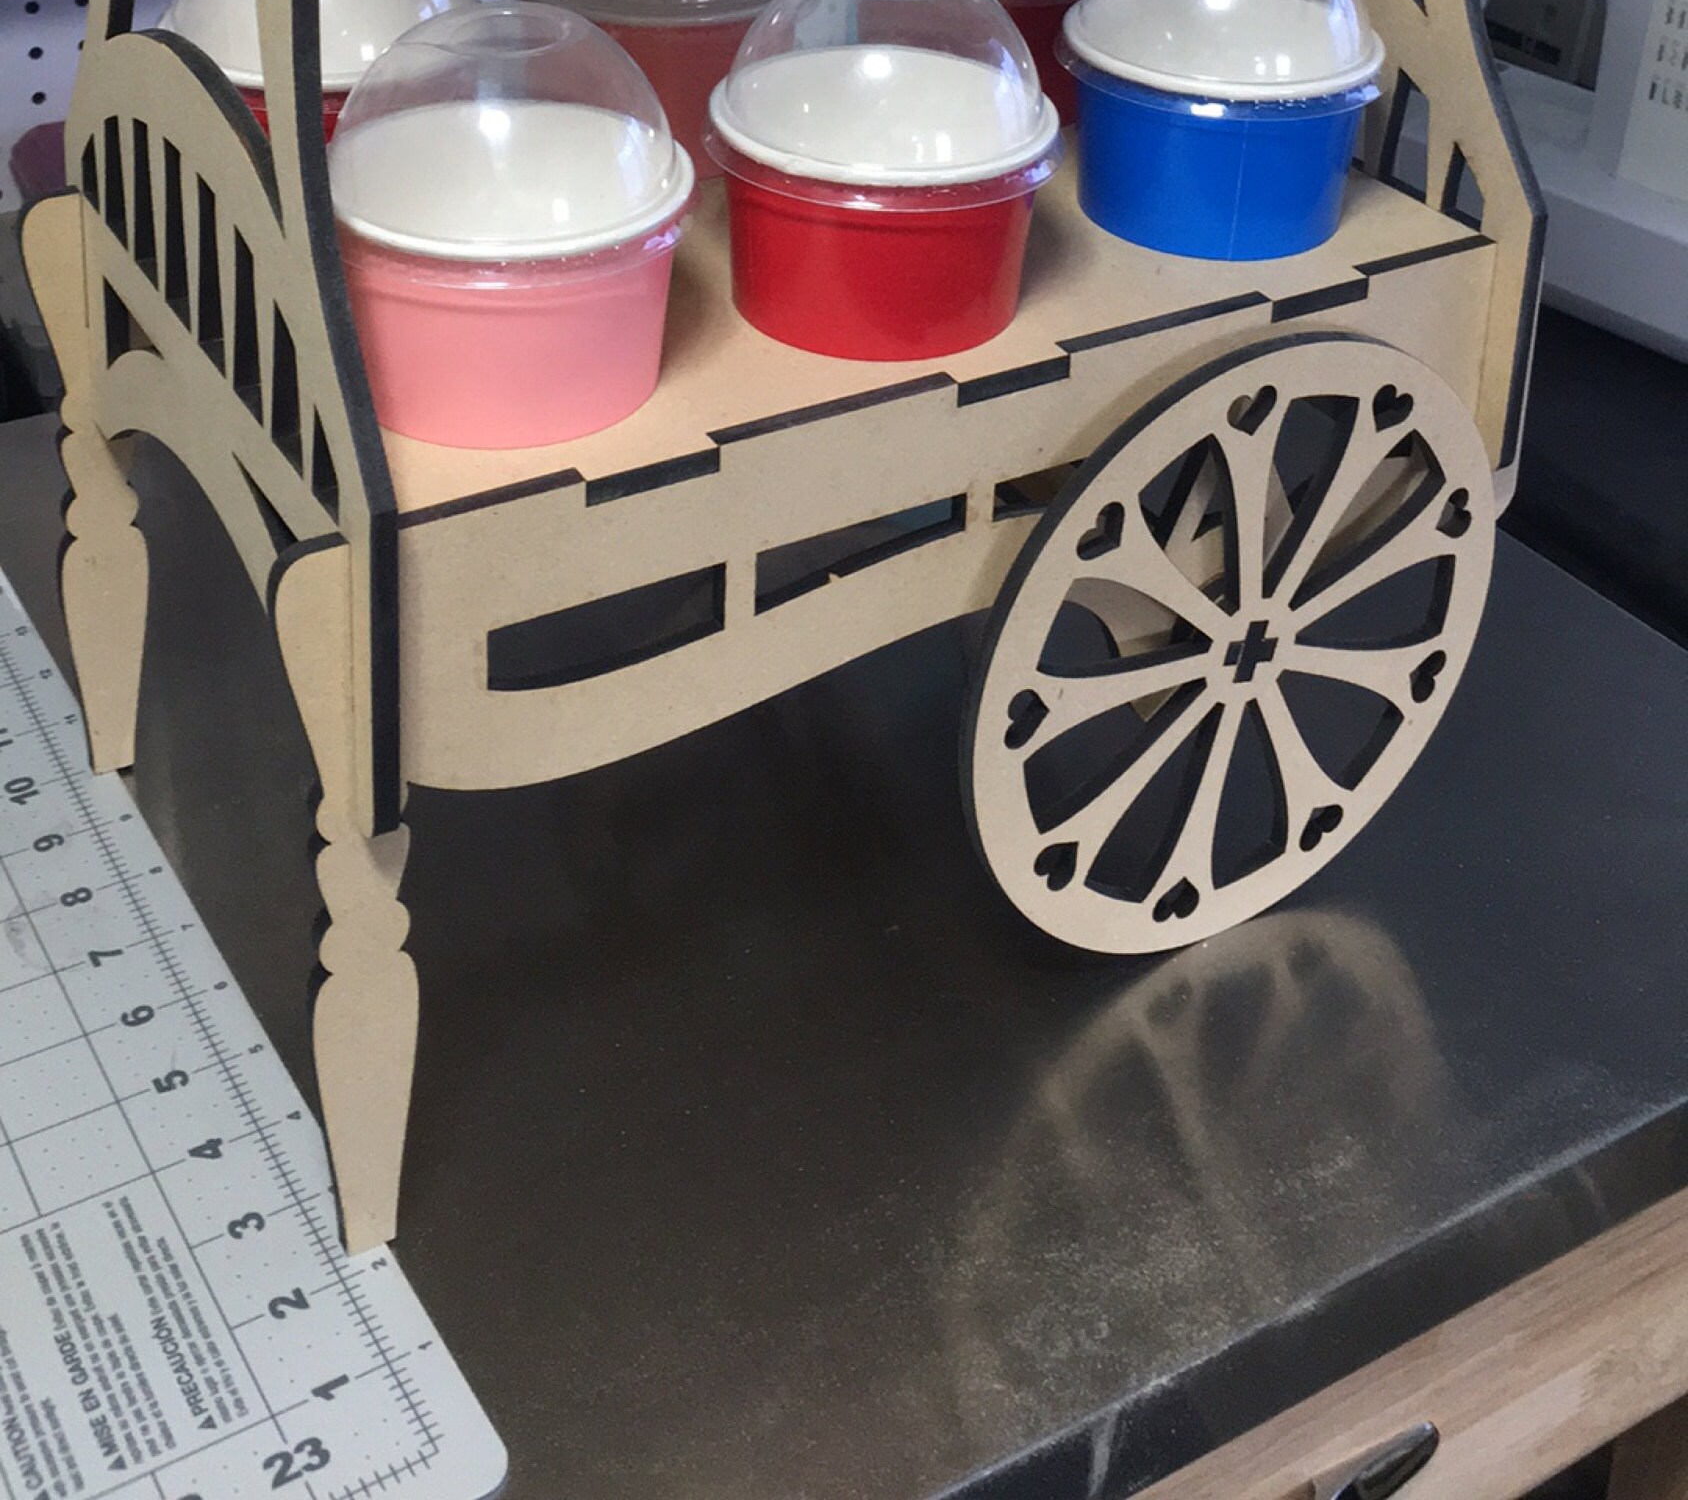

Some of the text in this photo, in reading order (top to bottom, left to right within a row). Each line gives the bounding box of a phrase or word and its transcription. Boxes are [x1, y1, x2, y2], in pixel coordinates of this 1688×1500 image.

[3, 776, 41, 806] 10
[32, 833, 65, 853] 9
[58, 886, 94, 908] 8
[87, 948, 124, 968] 7
[119, 1004, 156, 1028] 6
[151, 1069, 190, 1095] 5
[186, 1137, 224, 1161] 4
[226, 1211, 266, 1240] 3
[371, 1257, 388, 1271] 2
[267, 1286, 311, 1320] 2
[53, 1330, 90, 1386] GARDE
[150, 1315, 209, 1418] PRECAUCIÓN
[78, 1387, 101, 1414] EN
[310, 1373, 351, 1402] 1
[89, 1413, 121, 1457] MISE
[2, 1414, 45, 1491] CAUTION
[262, 1436, 332, 1490] 23
